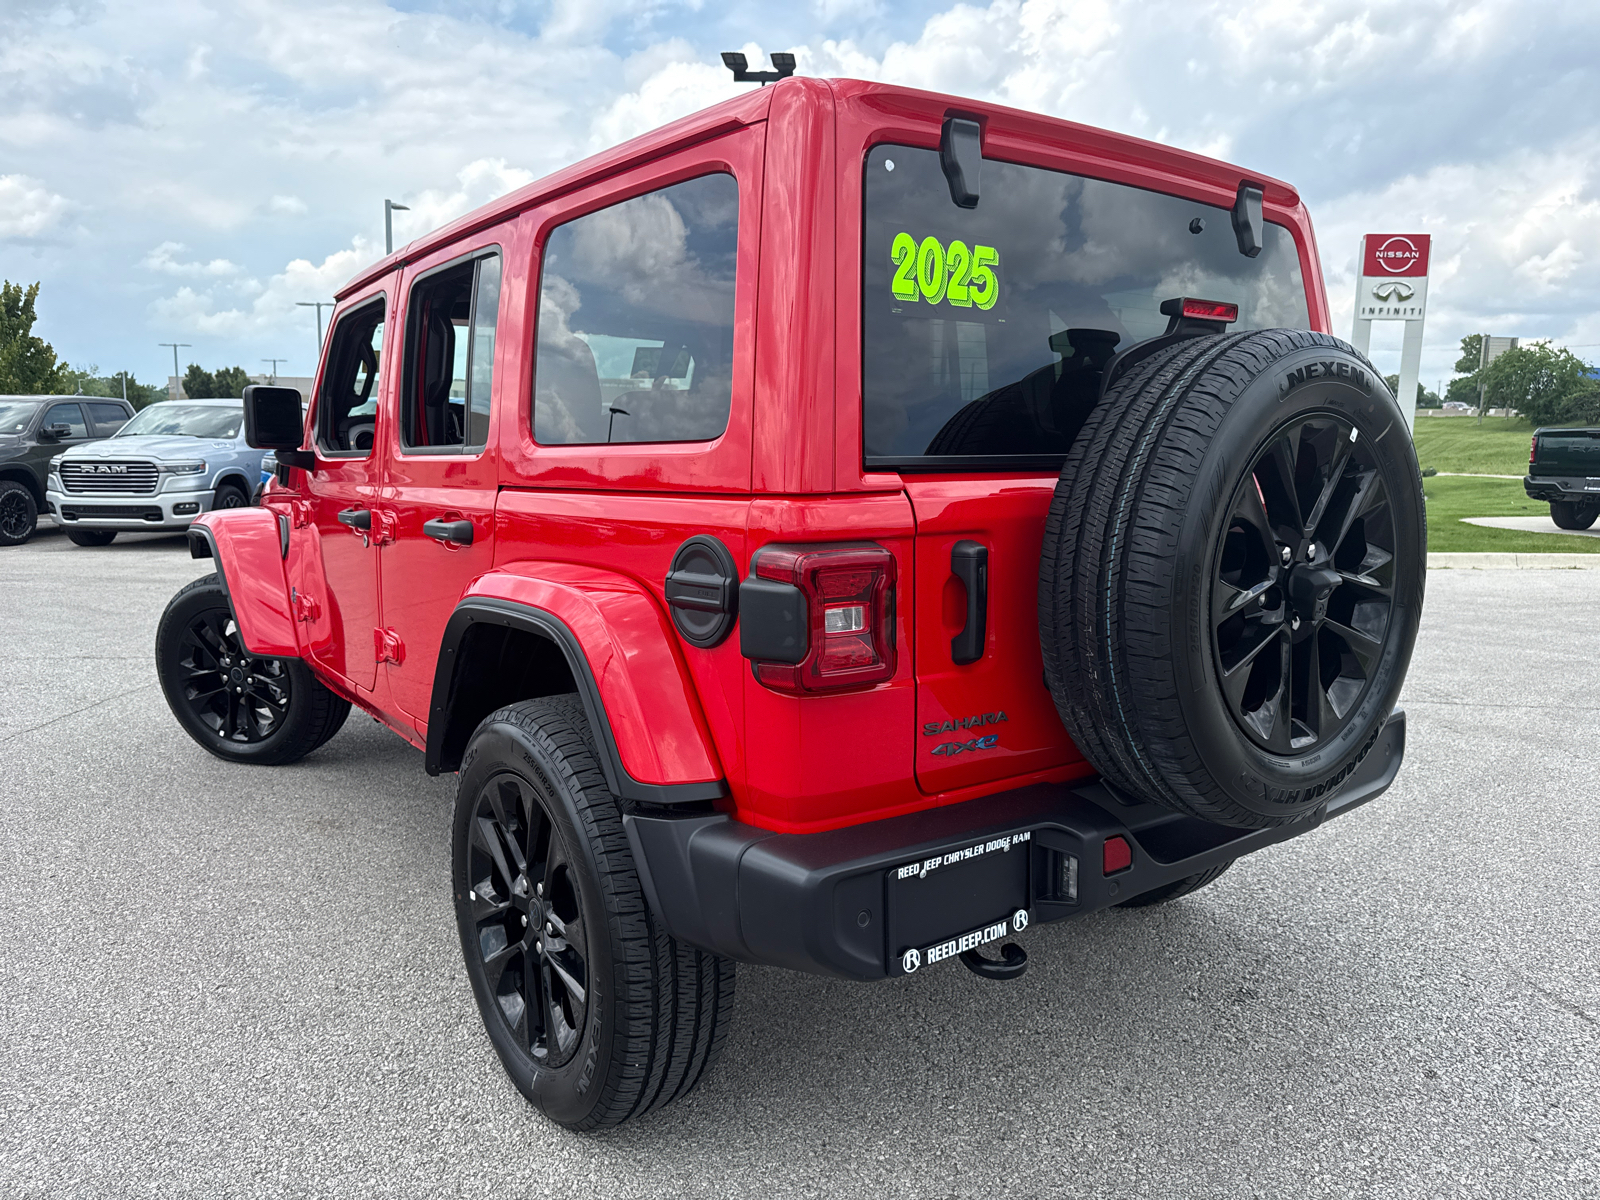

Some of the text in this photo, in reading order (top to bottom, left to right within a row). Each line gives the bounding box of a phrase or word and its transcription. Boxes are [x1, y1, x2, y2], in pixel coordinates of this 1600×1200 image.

[891, 232, 999, 311] 2025
[1361, 307, 1422, 316] INFINITI
[1286, 361, 1365, 390] NEXEN
[80, 465, 128, 474] RAM
[923, 710, 1009, 736] SAHARA
[522, 752, 555, 798] 255/60R20
[898, 831, 1031, 879] REED JEEP CHRYSLER DODGE RAM
[927, 922, 1007, 965] REEDJEEP.COM
[577, 989, 603, 1095] NEXEN
